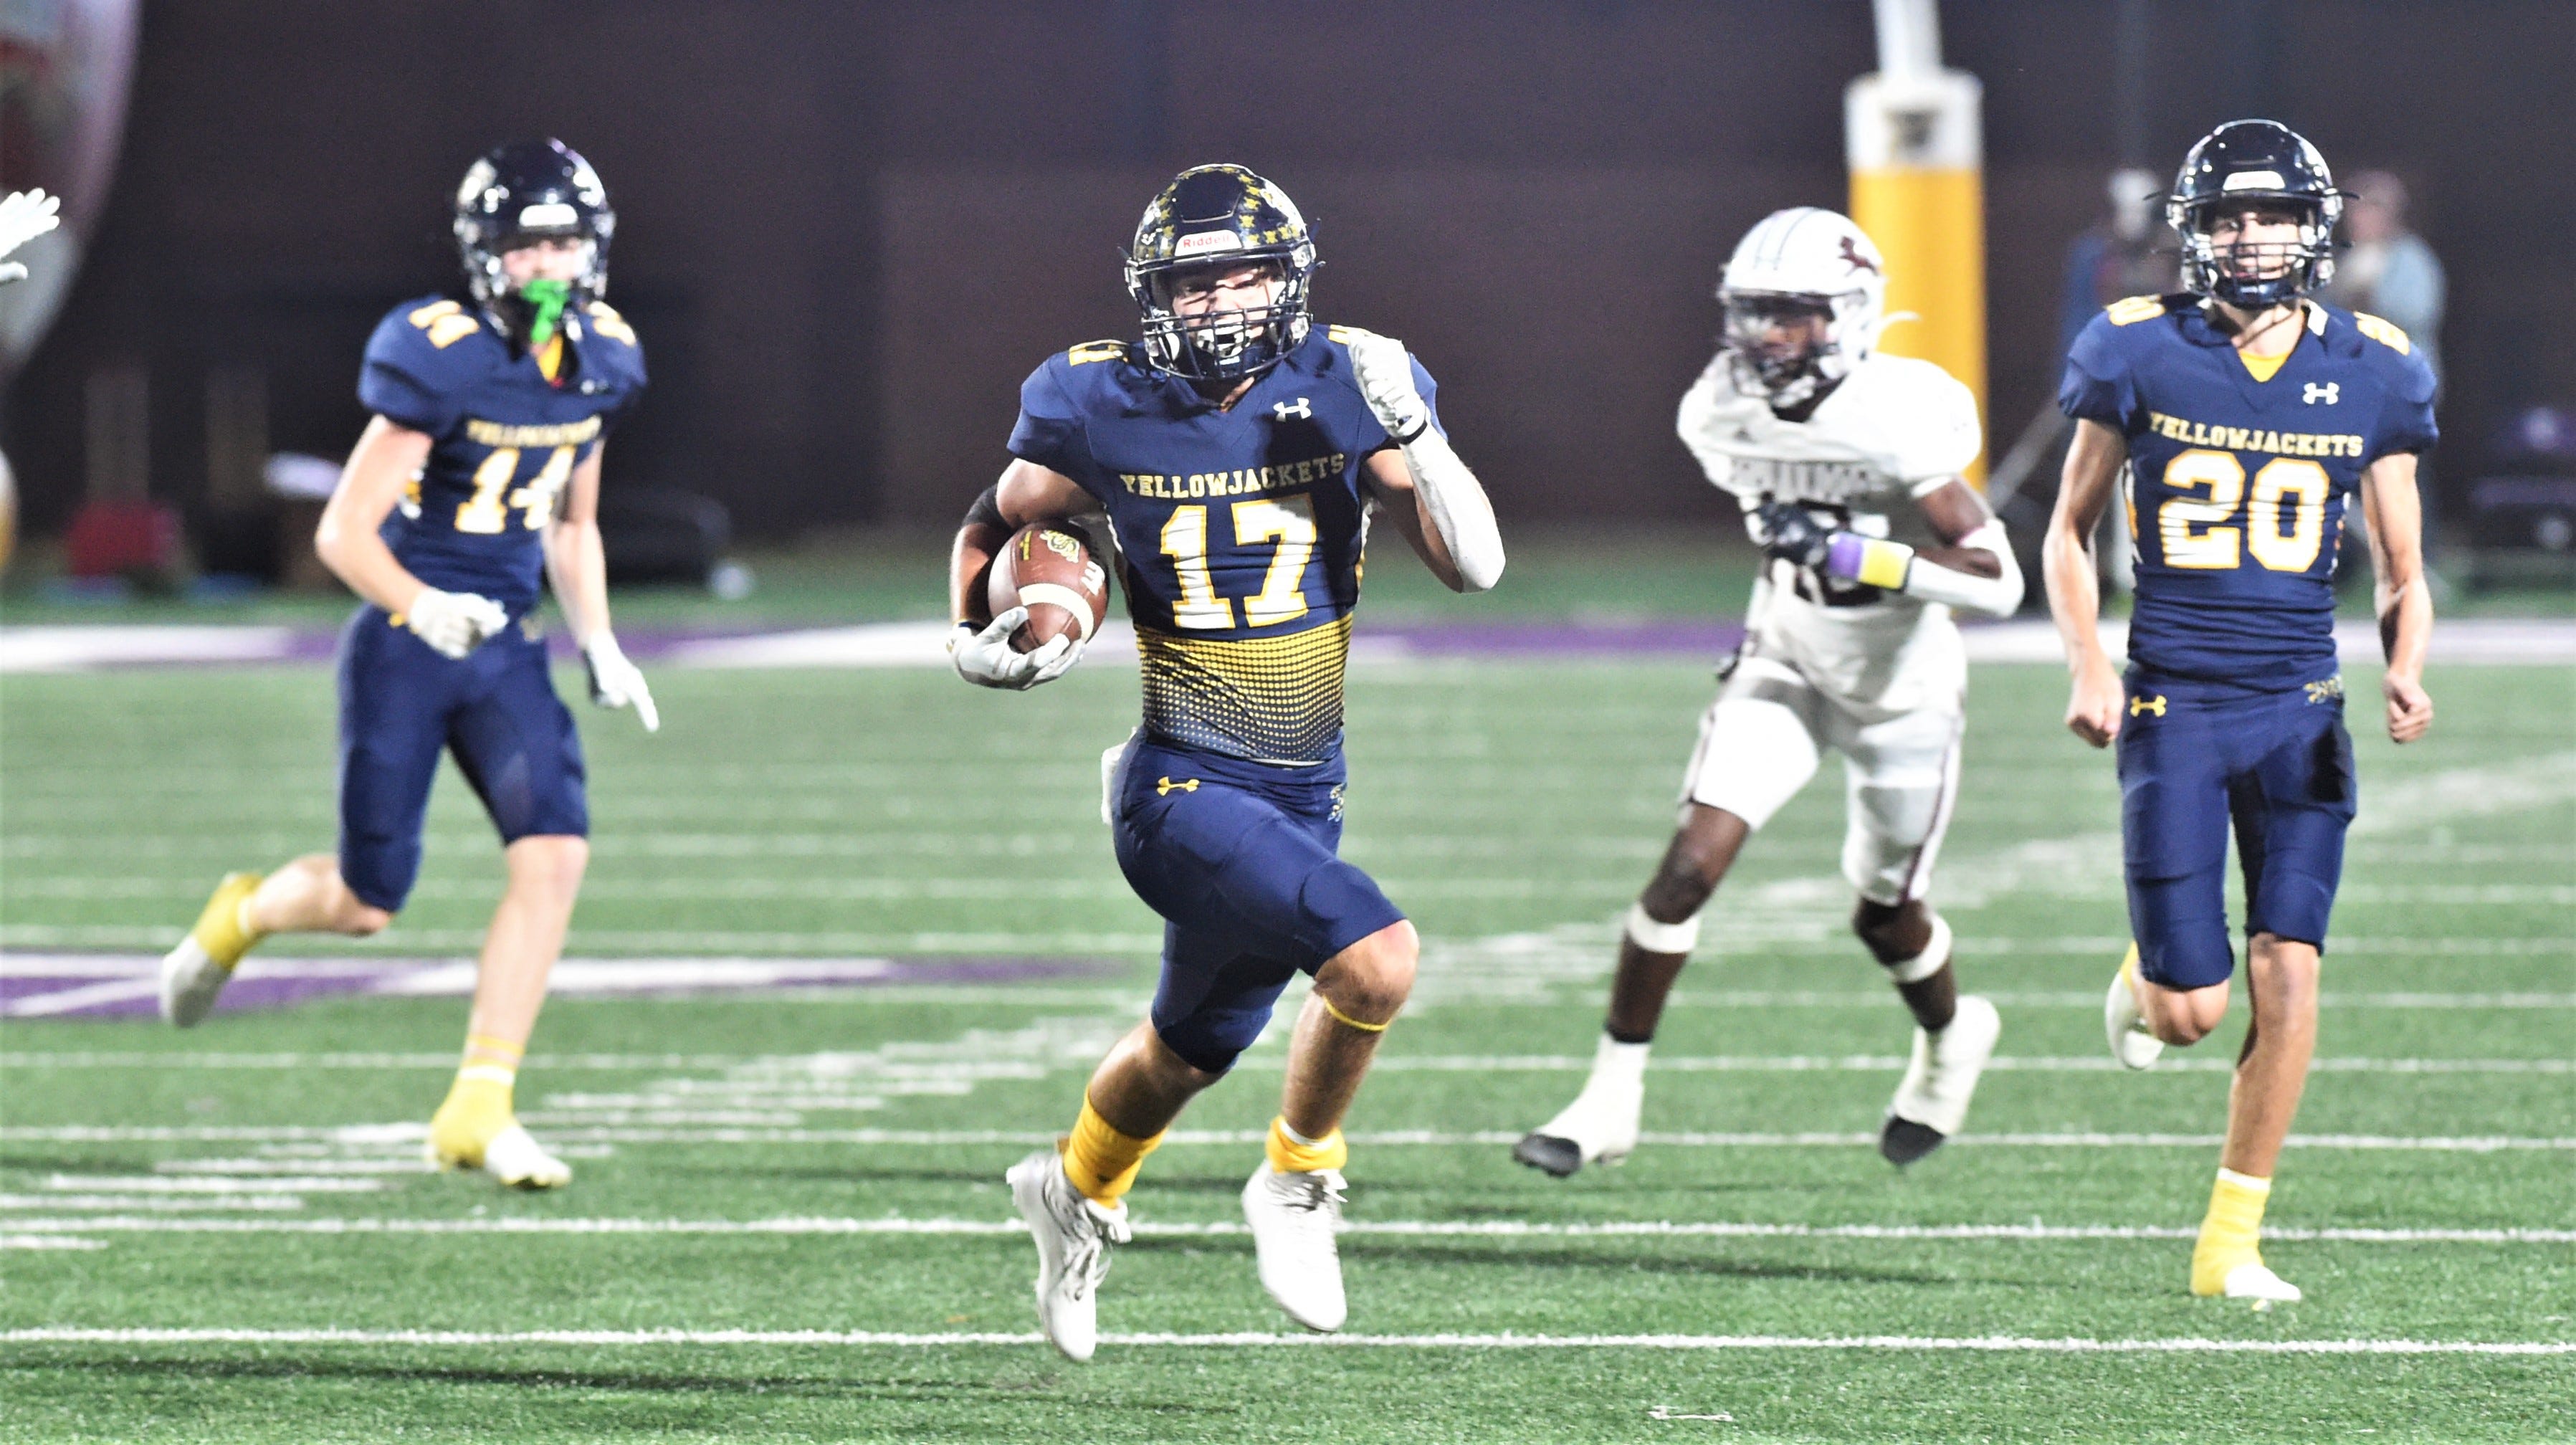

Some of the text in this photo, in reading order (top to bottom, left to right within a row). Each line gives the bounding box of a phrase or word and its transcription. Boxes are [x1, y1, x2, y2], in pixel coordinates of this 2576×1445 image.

[1183, 234, 1230, 248] Riddell
[2150, 411, 2364, 457] YELLOWJACKETS
[454, 443, 577, 534] 14
[1120, 453, 1345, 499] YELLOWJACKETS
[2158, 448, 2329, 573] 20
[1160, 492, 1317, 629] 17
